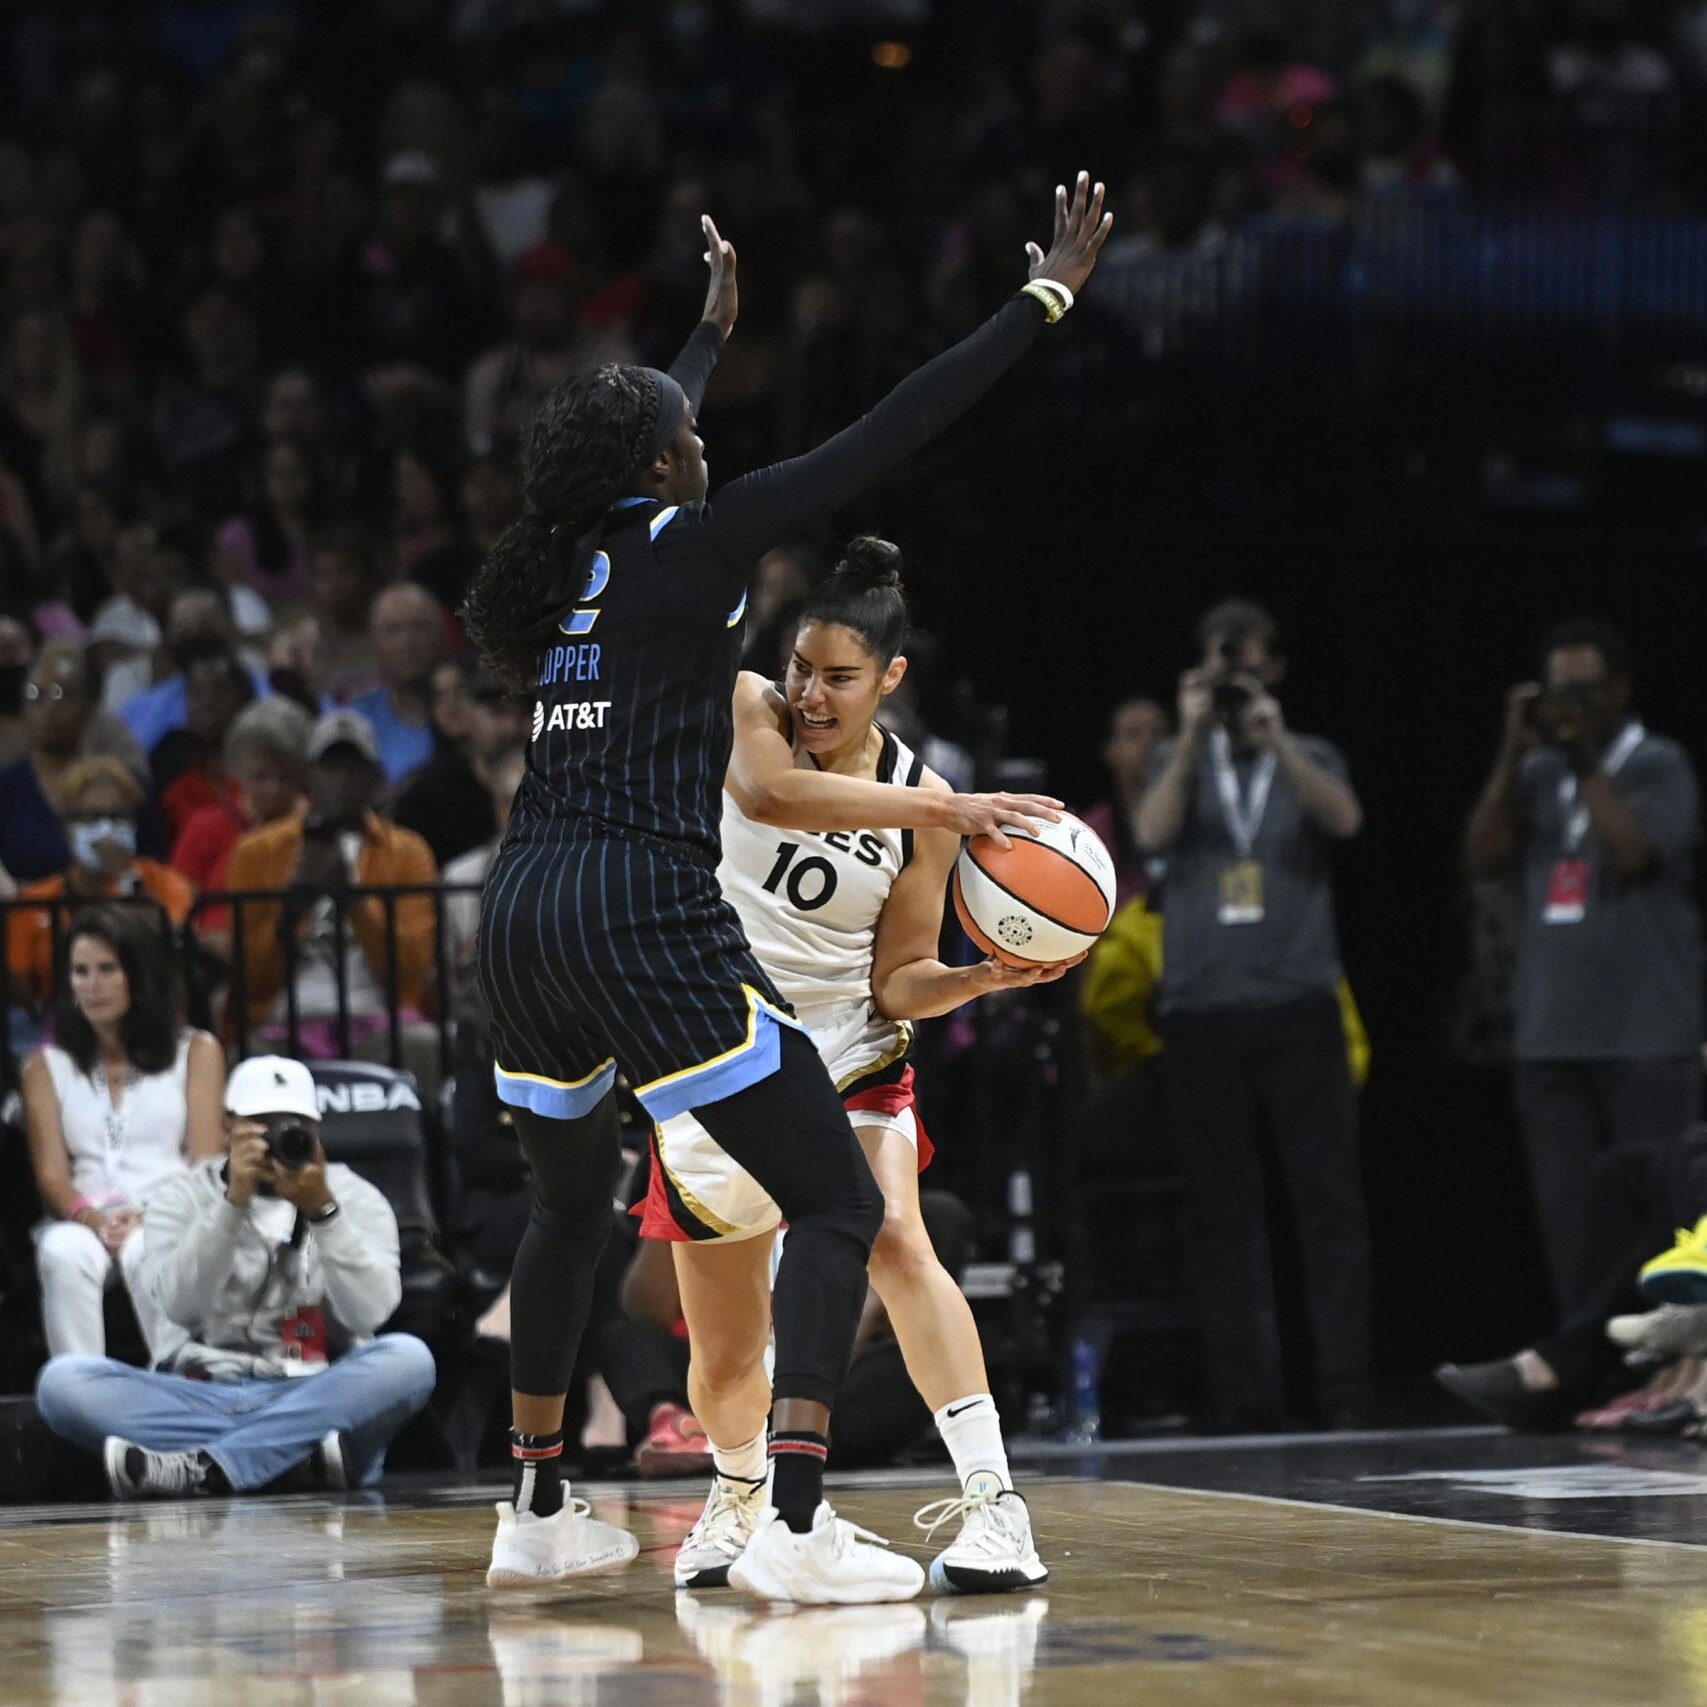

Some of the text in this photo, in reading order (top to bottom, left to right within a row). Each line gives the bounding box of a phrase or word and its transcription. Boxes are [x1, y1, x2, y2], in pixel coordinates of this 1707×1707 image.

[538, 643, 601, 687] OPPER
[546, 701, 612, 731] AT&T
[807, 831, 885, 866] ES
[762, 841, 838, 911] 10
